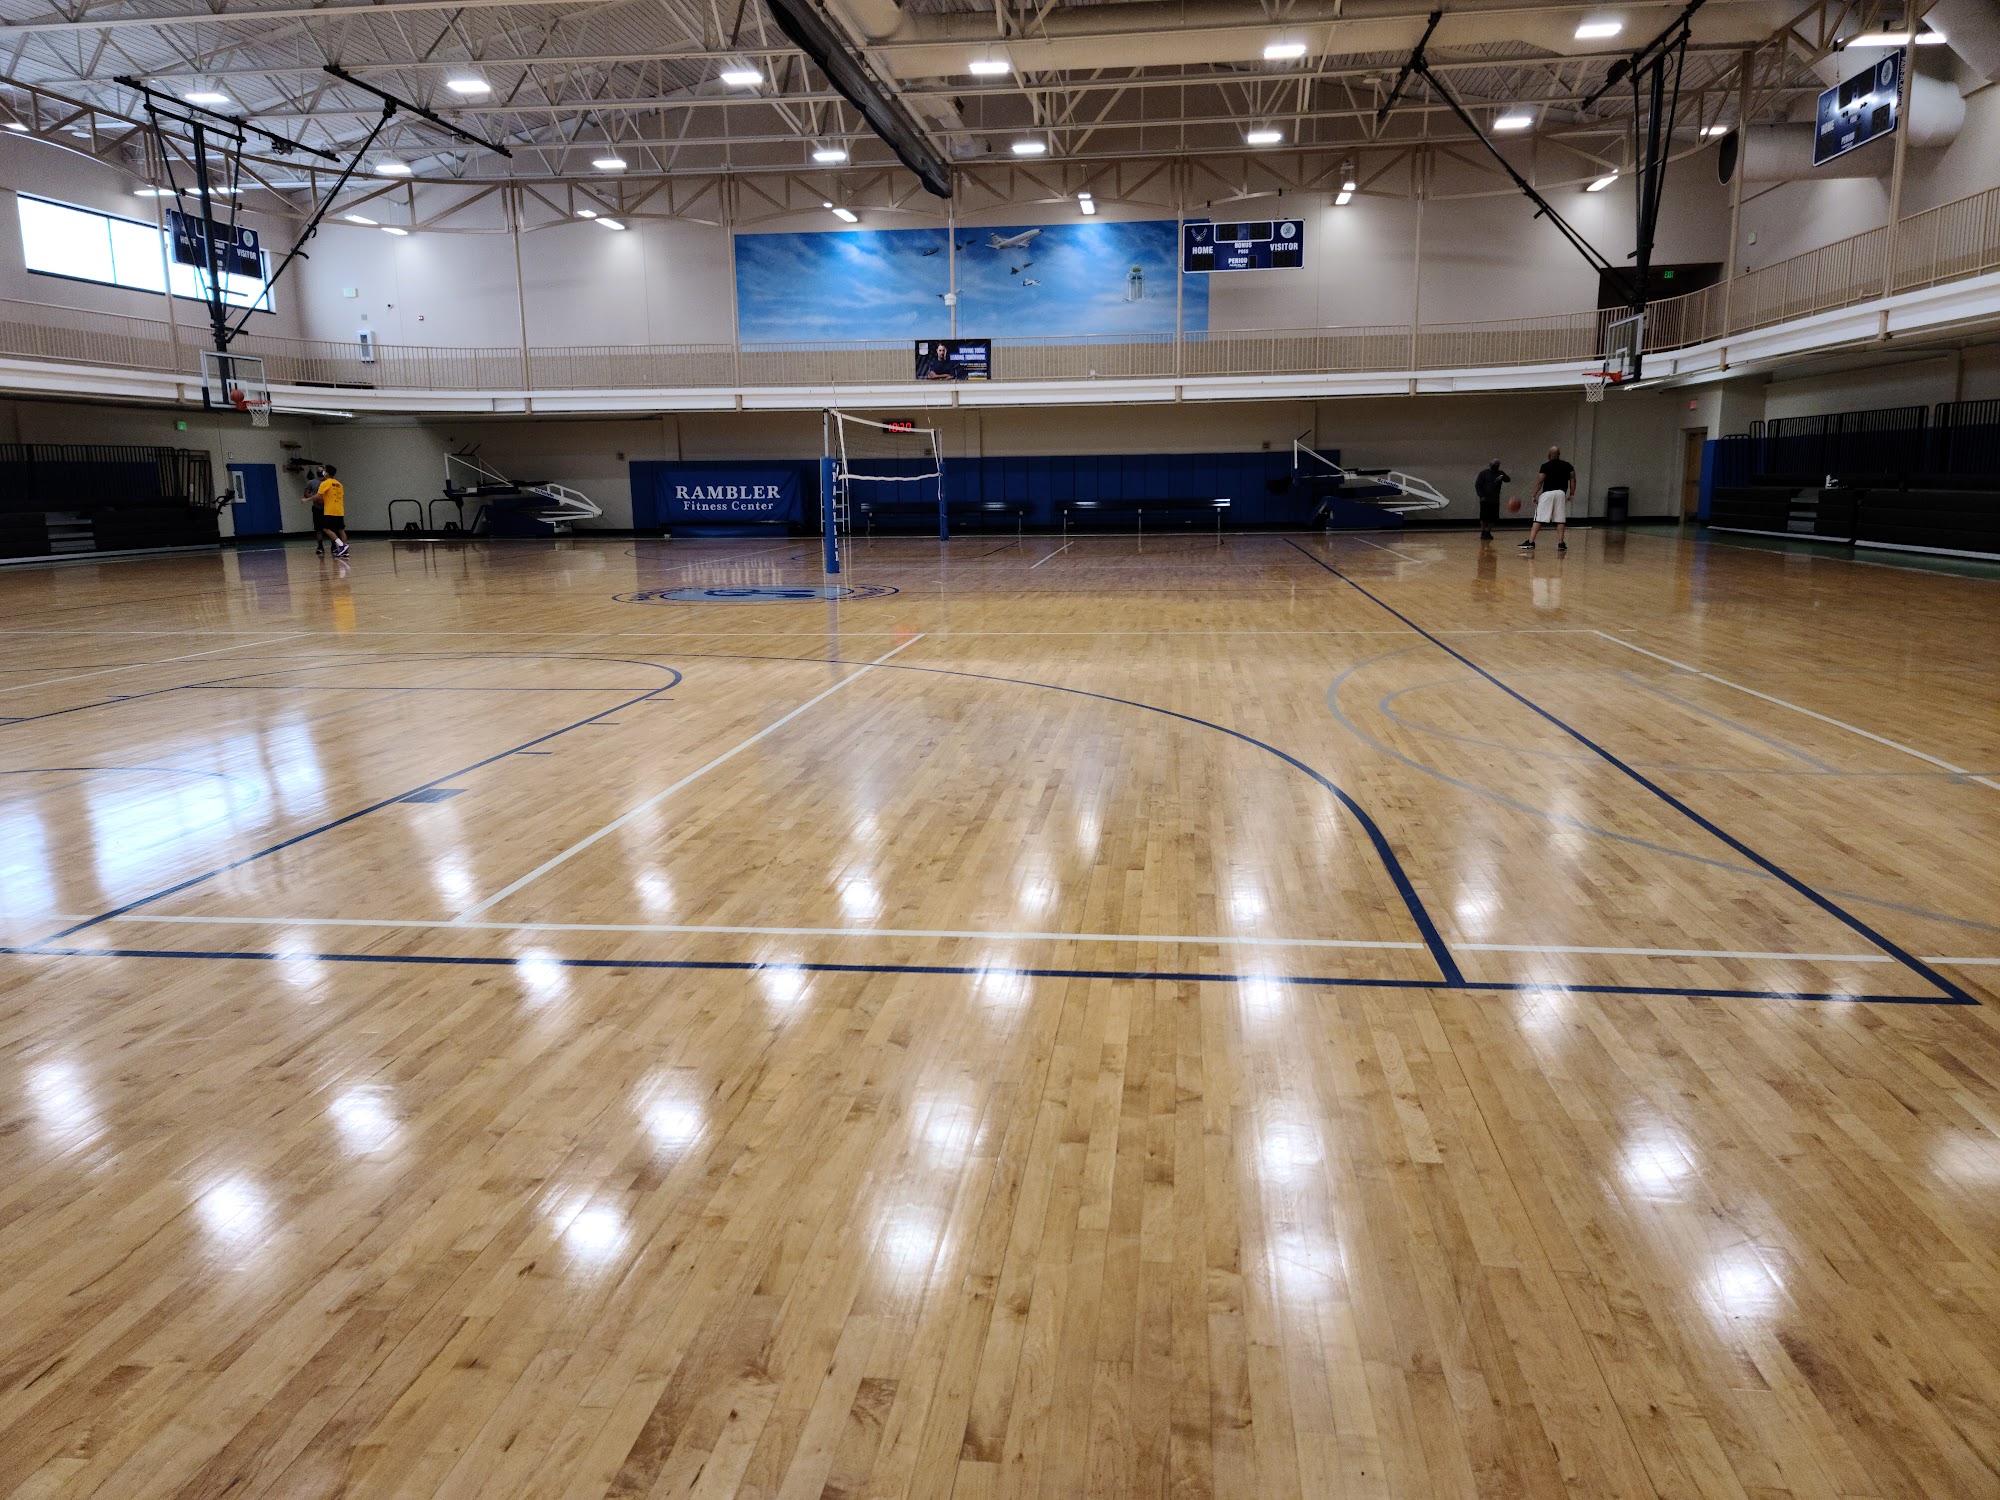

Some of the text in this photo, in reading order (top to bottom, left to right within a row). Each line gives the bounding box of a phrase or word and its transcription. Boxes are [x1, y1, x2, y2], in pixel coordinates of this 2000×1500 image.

[1192, 246, 1213, 254] HOME
[1270, 243, 1299, 251] VISITOR
[236, 248, 257, 260] VISITOR
[675, 485, 780, 499] RAMBLER
[683, 500, 774, 511] Fitness Center
